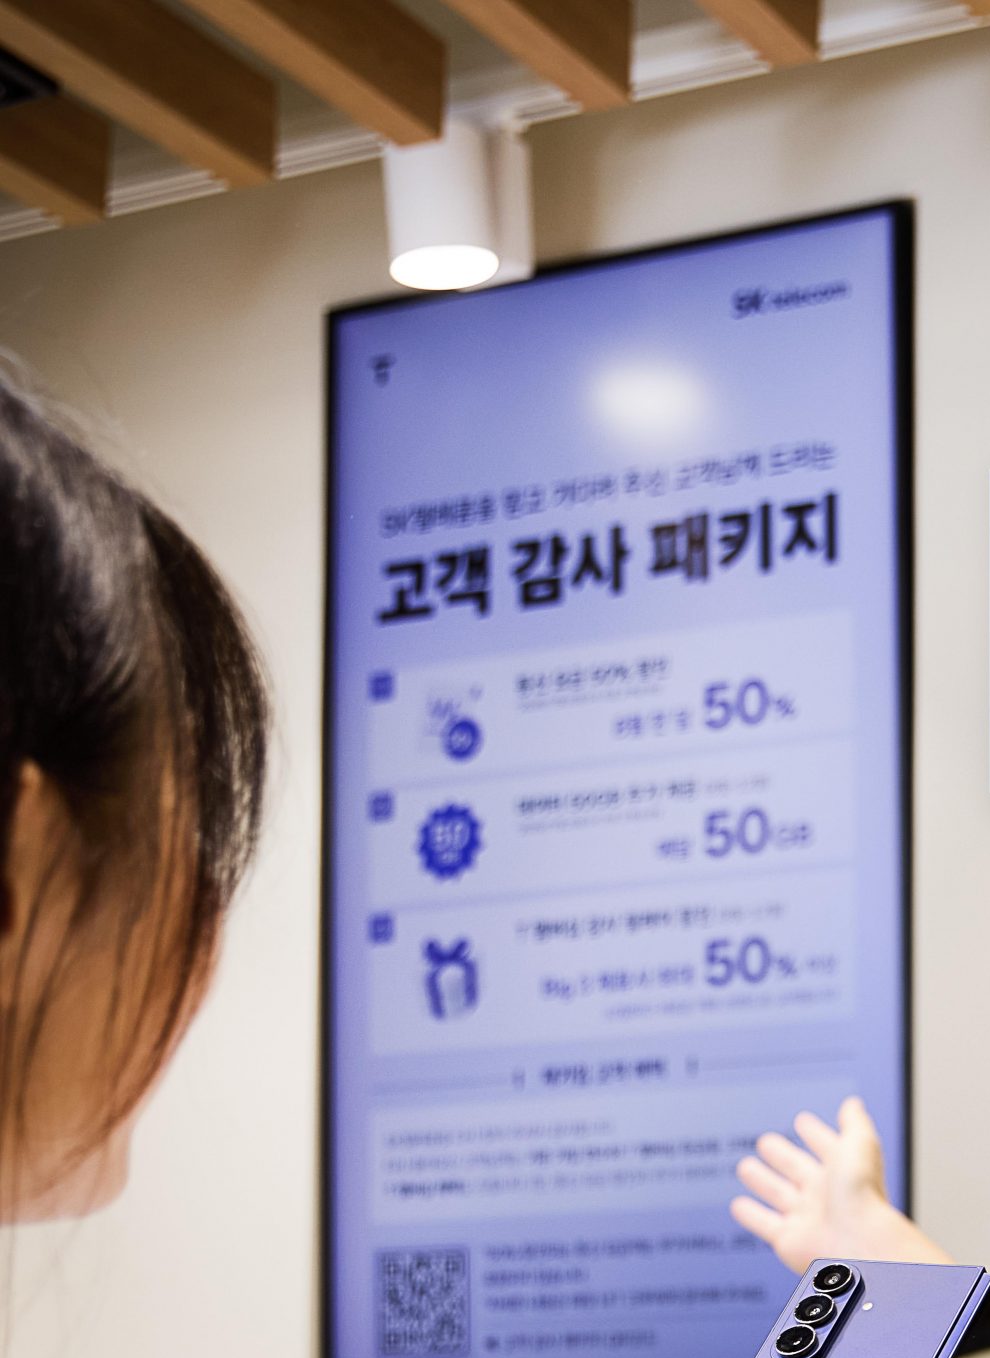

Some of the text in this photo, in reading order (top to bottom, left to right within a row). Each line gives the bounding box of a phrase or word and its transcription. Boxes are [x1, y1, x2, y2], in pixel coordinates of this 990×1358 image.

[375, 490, 840, 623] 고객 감사 패키지
